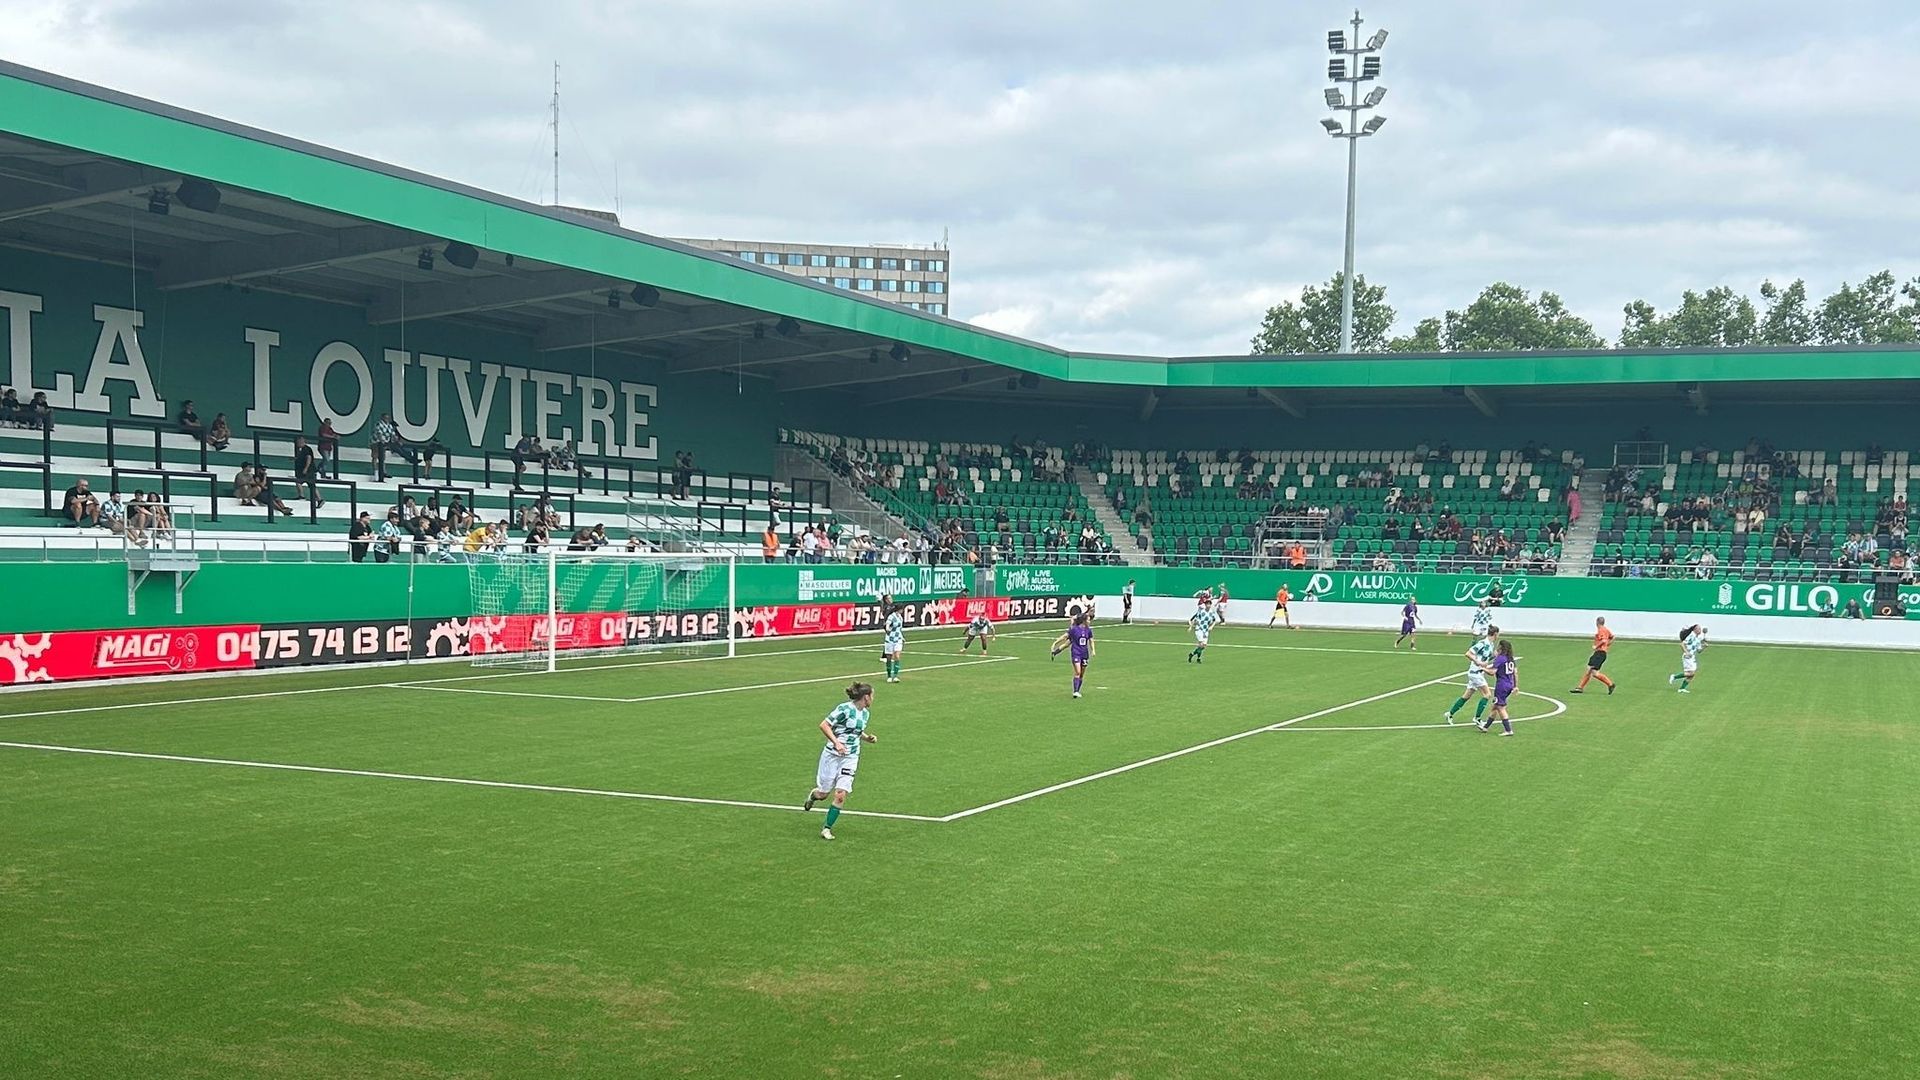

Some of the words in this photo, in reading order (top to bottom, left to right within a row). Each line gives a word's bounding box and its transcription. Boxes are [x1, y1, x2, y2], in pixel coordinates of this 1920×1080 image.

[0, 290, 167, 418] LA
[244, 327, 659, 461] LOUVIERE
[1031, 577, 1055, 585] MUSIC
[1034, 569, 1051, 577] LIVE
[1350, 575, 1418, 590] ALUDAN
[856, 578, 916, 597] CALANDRO
[1355, 591, 1377, 599] LASER
[1745, 584, 1839, 612] GILO
[837, 606, 871, 626] 0475
[601, 616, 650, 640] 0475
[656, 615, 677, 637] 74
[702, 613, 719, 634] 12
[217, 629, 299, 661] 0475
[308, 627, 345, 656] 74
[386, 625, 412, 652] 12
[1505, 661, 1515, 675] 19
